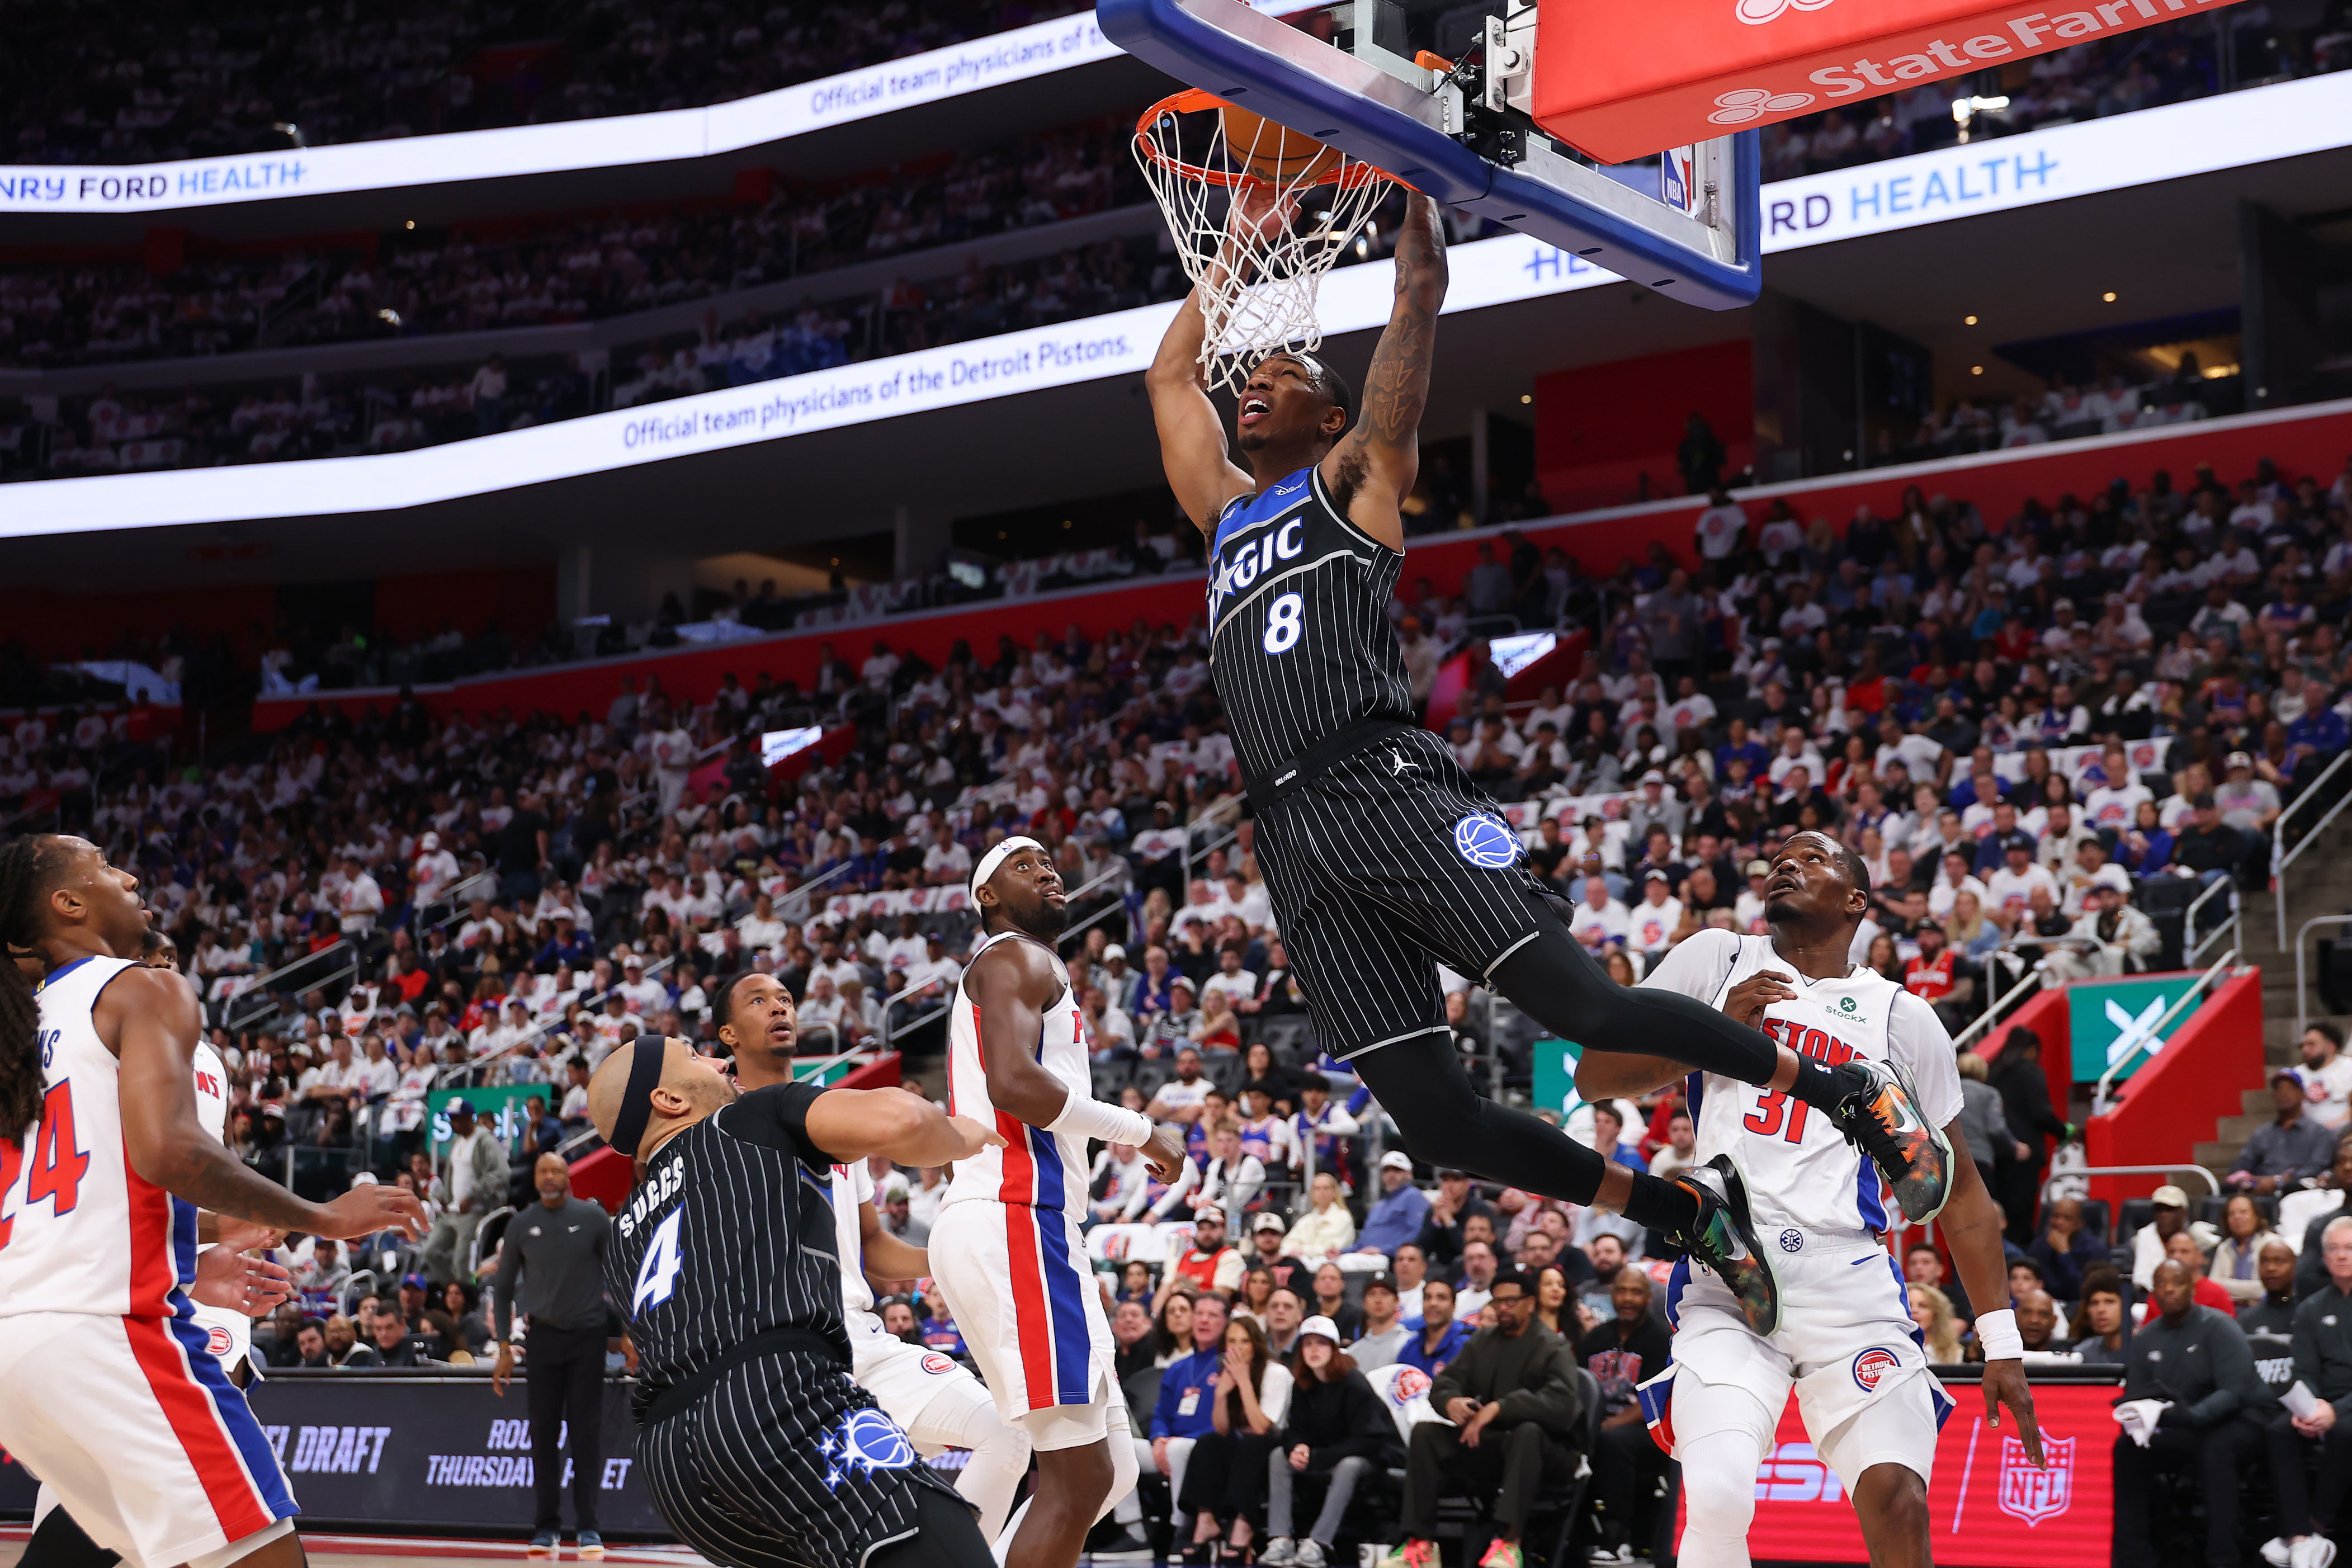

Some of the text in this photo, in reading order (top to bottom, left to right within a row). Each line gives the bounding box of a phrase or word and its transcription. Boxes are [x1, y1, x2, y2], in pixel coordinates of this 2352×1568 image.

[811, 75, 884, 115] Official
[890, 67, 941, 94] team
[945, 38, 1055, 88] physicians
[1059, 23, 1083, 54] of
[1809, 35, 2013, 98] State
[79, 174, 168, 200] FORD
[178, 160, 306, 196] HEALTH
[1666, 176, 1682, 204] NBA
[1760, 193, 1831, 235] RD
[1850, 150, 2059, 221] HEALTH
[624, 332, 1135, 451] Official team physicians of the Detroit Pistons.
[1262, 591, 1305, 656] 8
[1825, 1005, 1867, 1024] StockX
[1743, 1084, 1810, 1145] 31
[619, 1155, 684, 1239] SUGGS
[632, 1199, 685, 1324] 4
[1860, 1359, 1891, 1372] DETROIT
[1862, 1367, 1885, 1380] PISTO
[291, 1425, 392, 1475] DRAFT
[600, 1458, 633, 1491] ET
[2008, 1471, 2063, 1511] NFL
